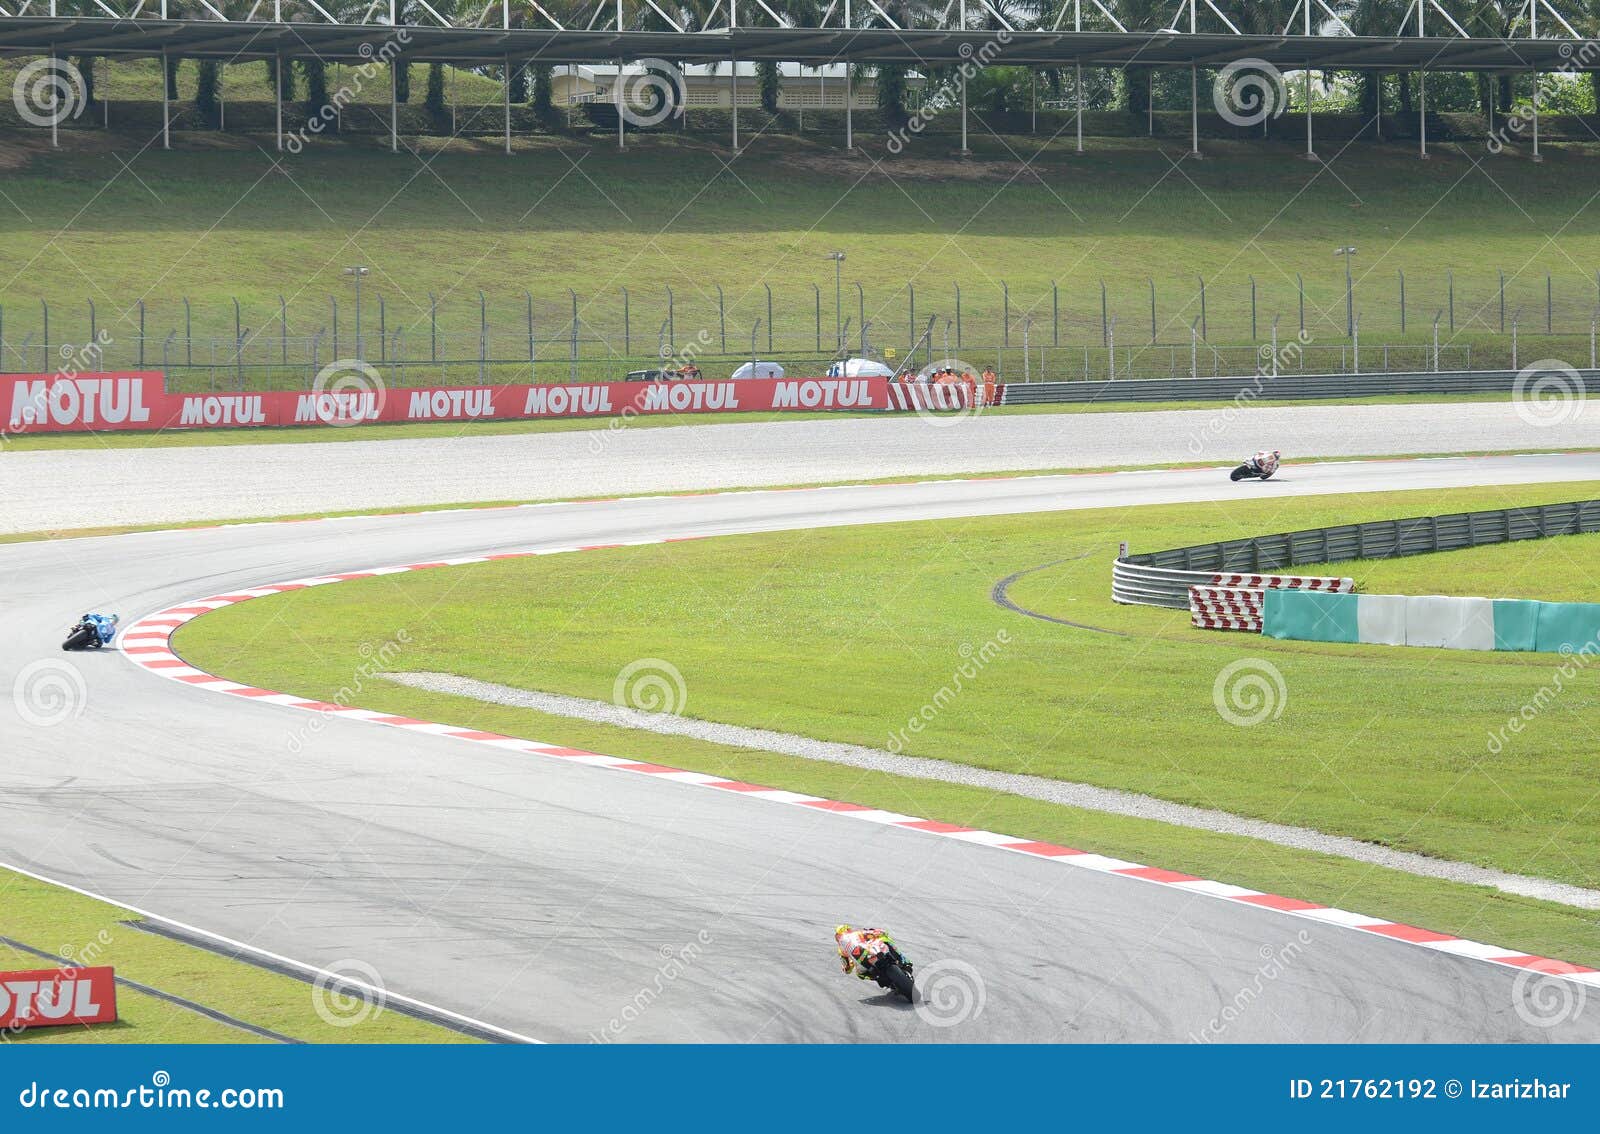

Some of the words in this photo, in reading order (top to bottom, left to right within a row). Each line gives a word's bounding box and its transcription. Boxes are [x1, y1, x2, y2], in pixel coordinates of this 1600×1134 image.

[10, 378, 150, 425] MOTUL
[294, 393, 379, 421] MOTUL
[408, 390, 495, 418] MOTUL
[524, 386, 612, 414] MOTUL
[643, 383, 739, 411] MOTUL
[772, 380, 873, 407] MOTUL
[180, 396, 266, 424] MOTUL
[0, 979, 100, 1018] TUL
